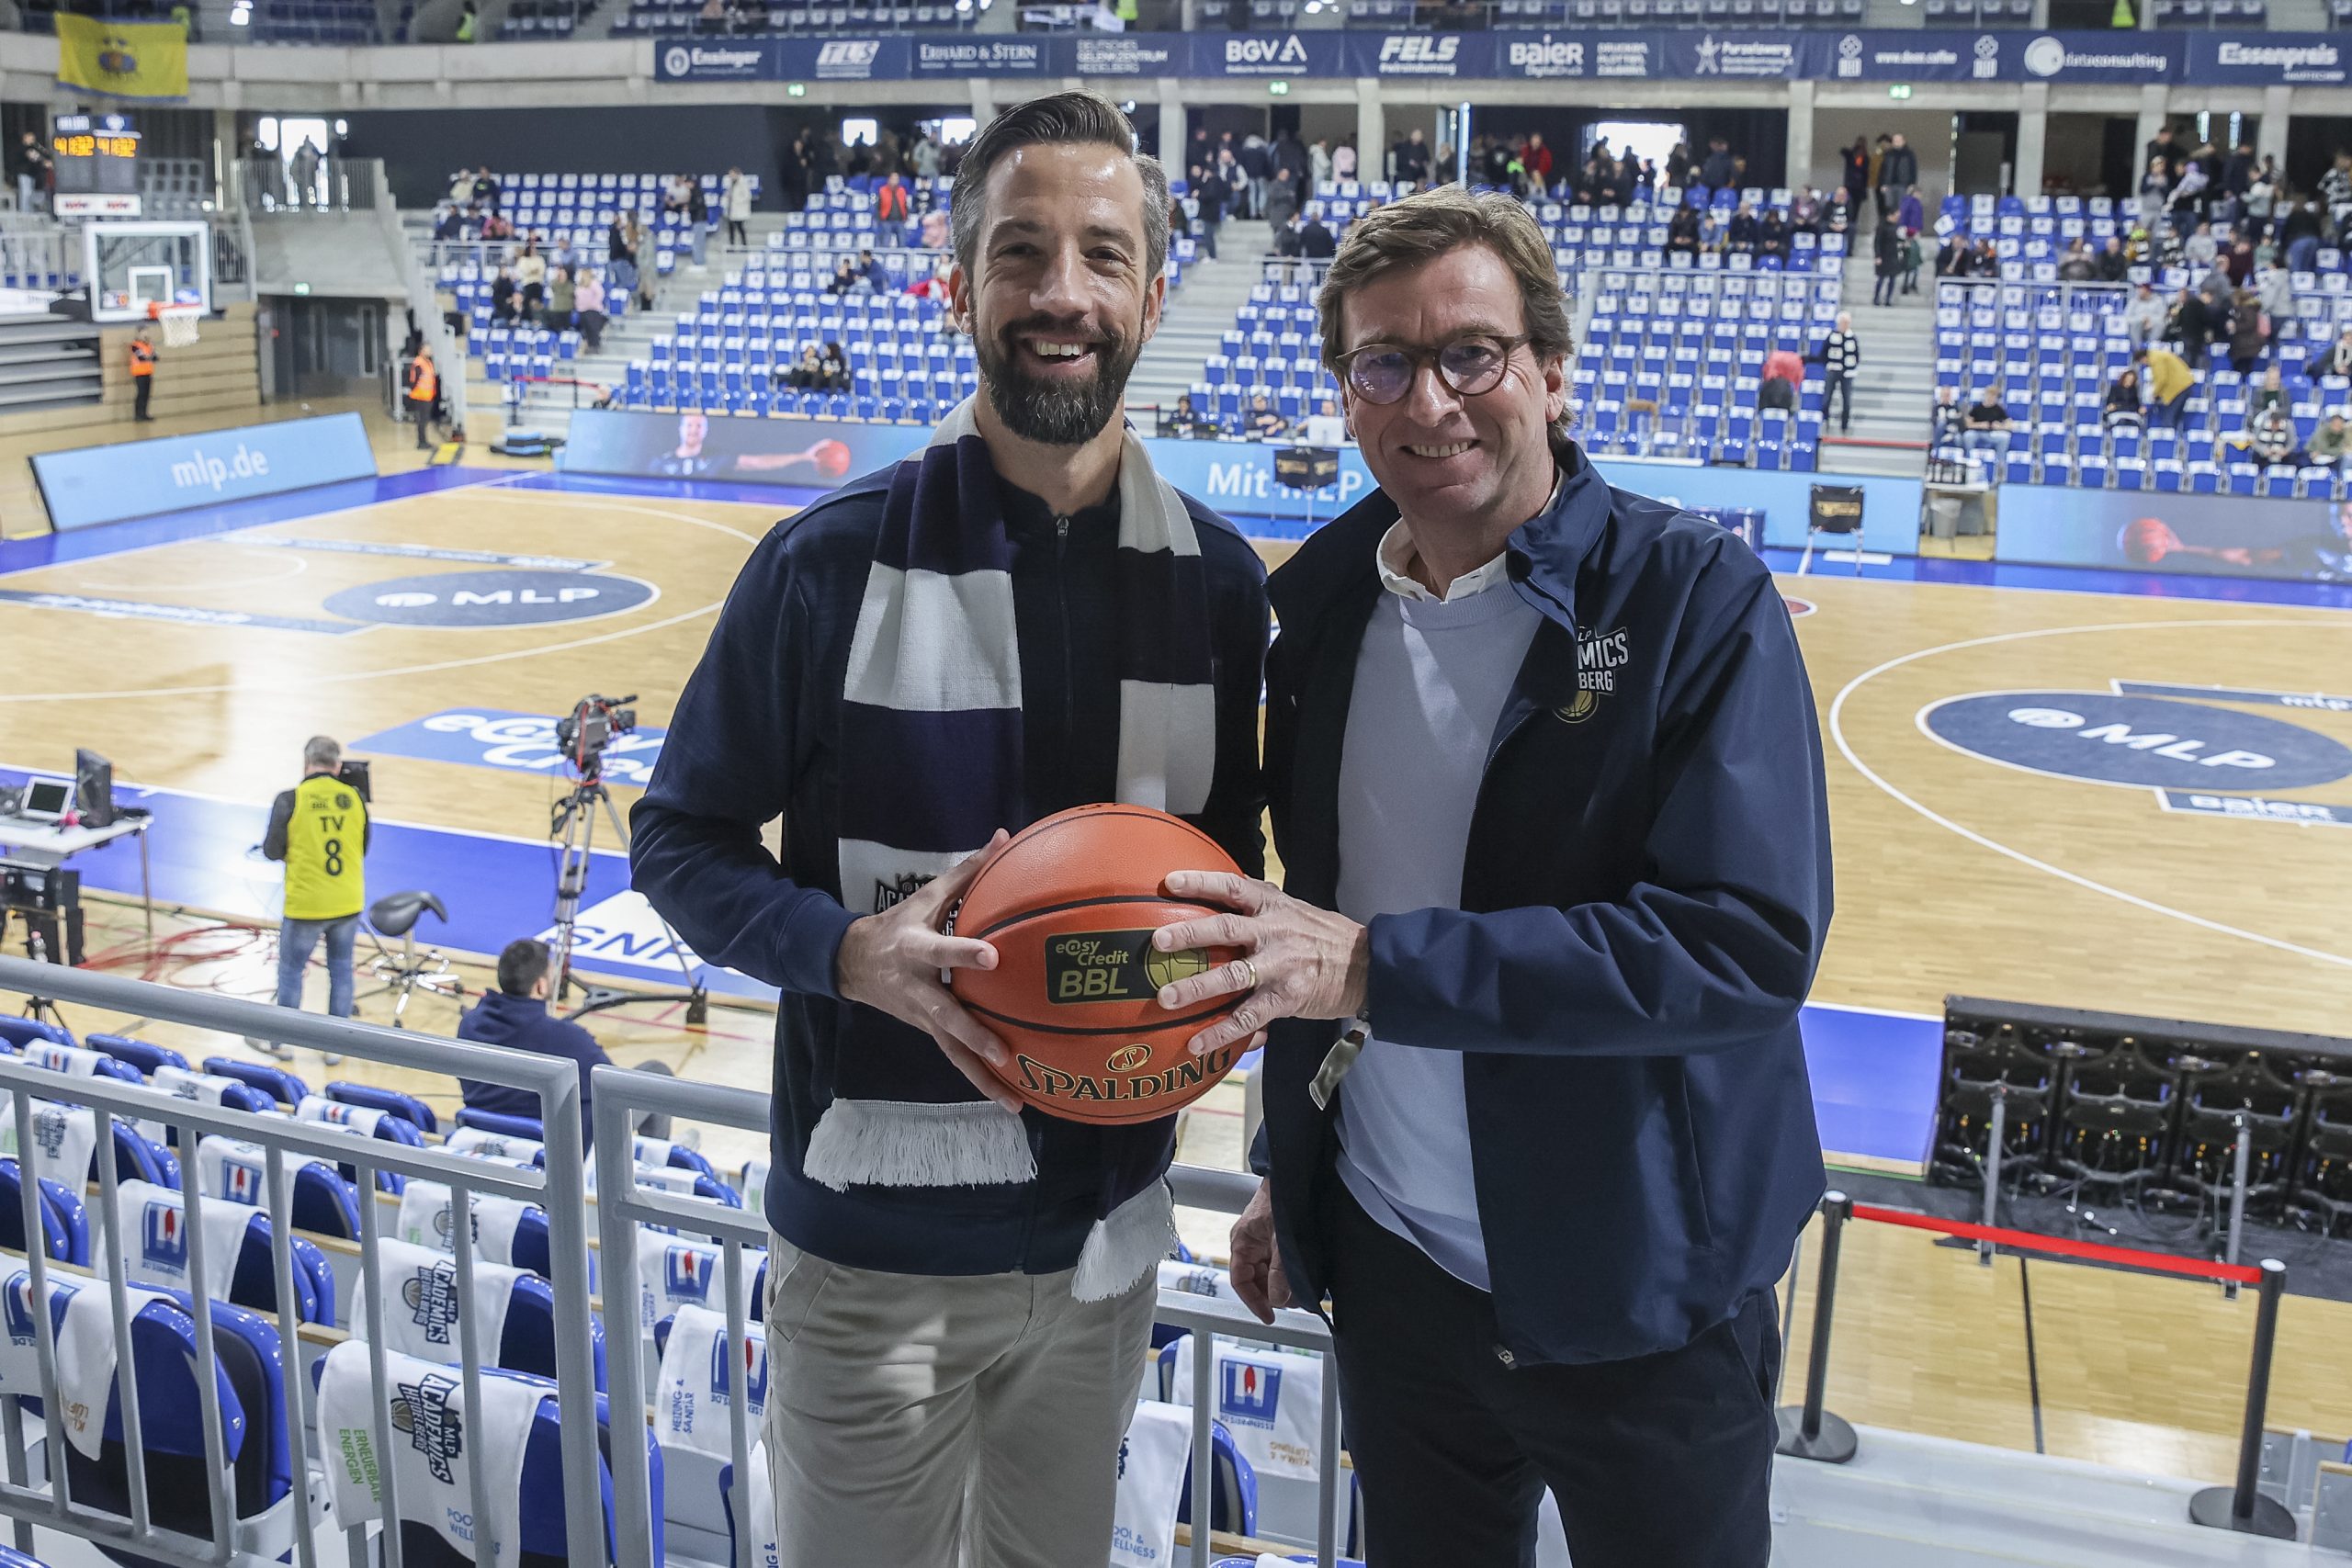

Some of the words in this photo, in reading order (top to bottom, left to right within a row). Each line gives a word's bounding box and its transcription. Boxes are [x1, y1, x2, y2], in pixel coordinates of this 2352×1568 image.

[1379, 36, 1461, 62] FELS
[171, 443, 269, 492] mlp.de
[1207, 461, 1269, 499] Mit
[452, 588, 600, 606] MLP
[1577, 671, 1613, 691] BERG
[2076, 723, 2277, 769] MLP
[320, 816, 345, 832] TV
[325, 840, 342, 876] 8
[1077, 950, 1129, 966] Credit
[1058, 967, 1128, 998] BBL
[1016, 1048, 1231, 1100] SPALDING
[427, 1260, 457, 1342] ACADEMICS
[401, 1385, 429, 1453] HEIDELBERG
[421, 1375, 454, 1482] ACADEMICS
[339, 1428, 364, 1484] ENERGIEN
[444, 1427, 457, 1454] MLP
[447, 1506, 473, 1527] POO
[1114, 1526, 1132, 1540] OOL
[1114, 1538, 1156, 1560] ELLNESS
